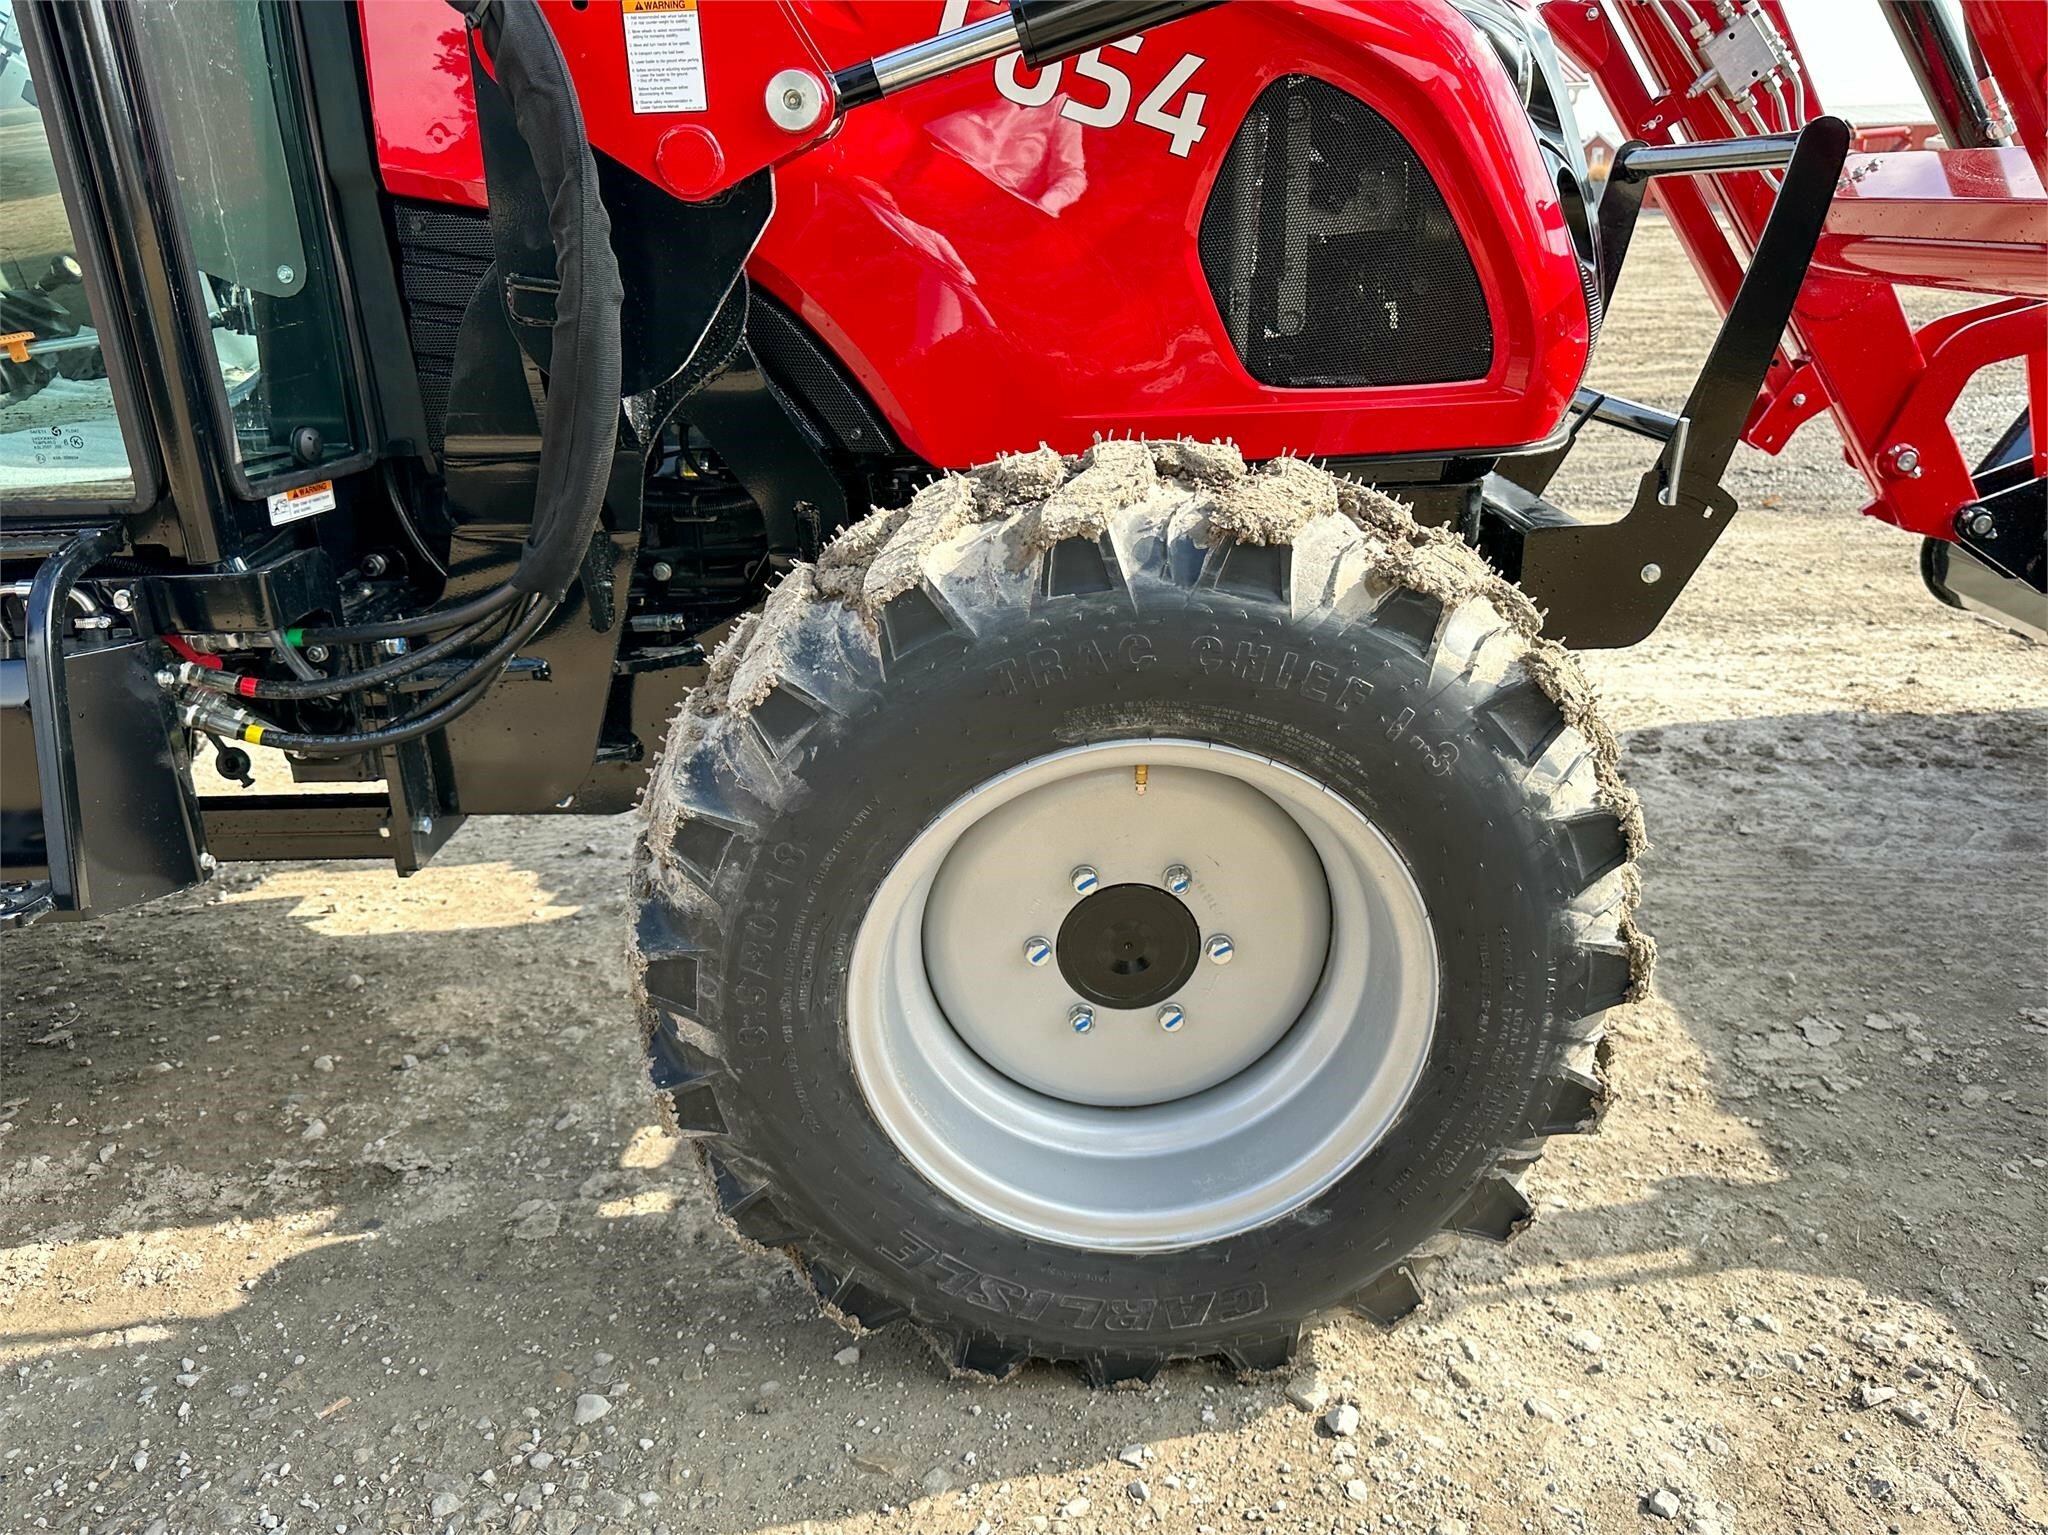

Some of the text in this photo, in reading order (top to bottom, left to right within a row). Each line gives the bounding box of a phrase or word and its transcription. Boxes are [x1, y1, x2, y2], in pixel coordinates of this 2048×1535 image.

[644, 1, 686, 10] WARNING
[299, 483, 327, 495] WARNING
[985, 634, 1158, 696] TRAC
[1191, 635, 1376, 707] CHIEF
[876, 1230, 1270, 1331] CARLISLE
